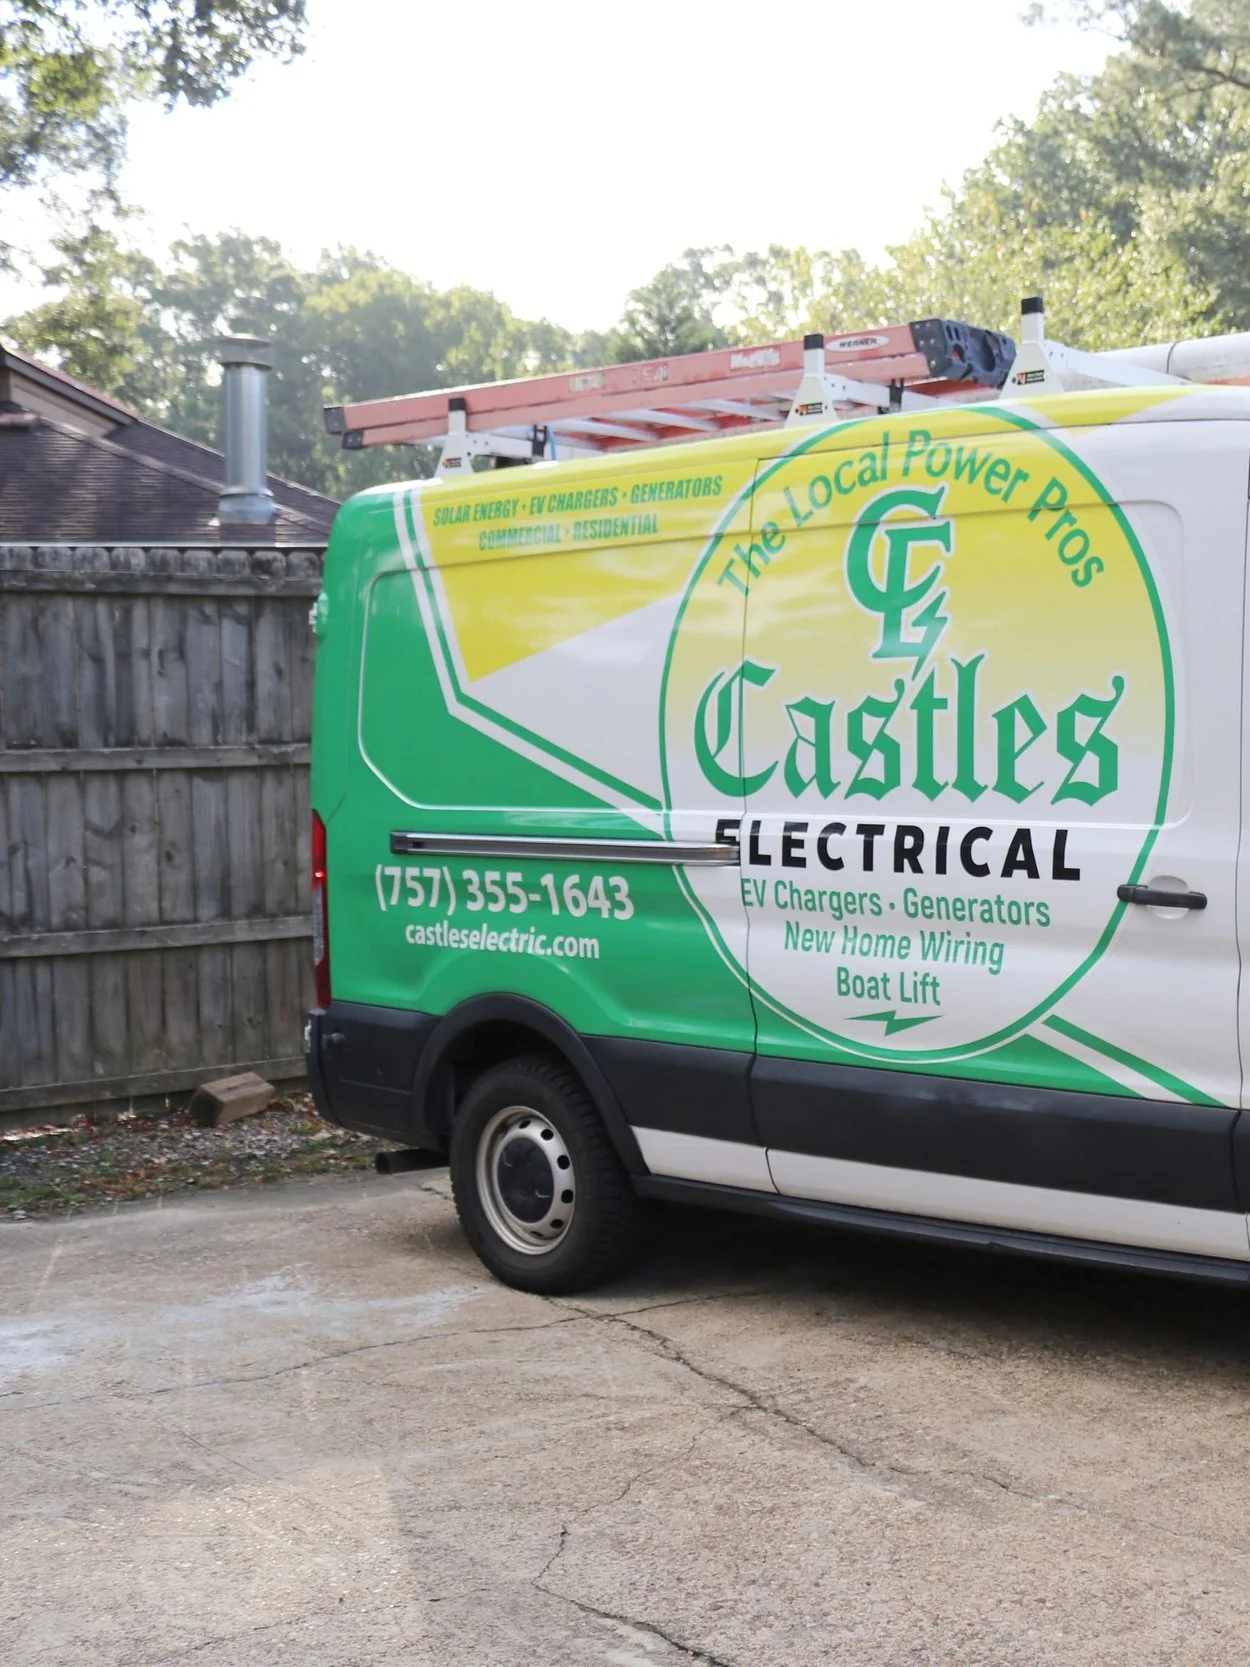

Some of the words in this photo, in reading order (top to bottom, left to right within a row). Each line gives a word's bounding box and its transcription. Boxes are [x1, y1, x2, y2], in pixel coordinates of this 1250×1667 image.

[839, 337, 878, 348] WERNER
[433, 504, 471, 526] SOLAR
[472, 498, 519, 523] ENERGY
[529, 495, 546, 515] EV
[547, 486, 619, 514] CHARGERS
[630, 474, 723, 504] GENERATORS
[716, 520, 786, 598] The
[783, 431, 890, 529] Local
[901, 429, 1030, 503] Power
[1027, 476, 1105, 588] Pros
[478, 522, 562, 550] COMMERCIAL
[573, 513, 659, 541] RESIDENTIAL
[693, 653, 1125, 807] Castles
[714, 818, 1081, 882] ELECTRICAL
[374, 863, 457, 917] (757)
[461, 868, 635, 921] 355-1643
[740, 877, 767, 908] EV
[773, 879, 883, 922] Chargers
[902, 886, 1051, 928] Generators
[404, 919, 601, 960] castleselectric.com
[783, 919, 836, 954] New
[841, 924, 912, 961] Home
[918, 929, 1005, 976] Wiring
[836, 965, 892, 1002] Boat
[899, 970, 942, 1007] Lift
